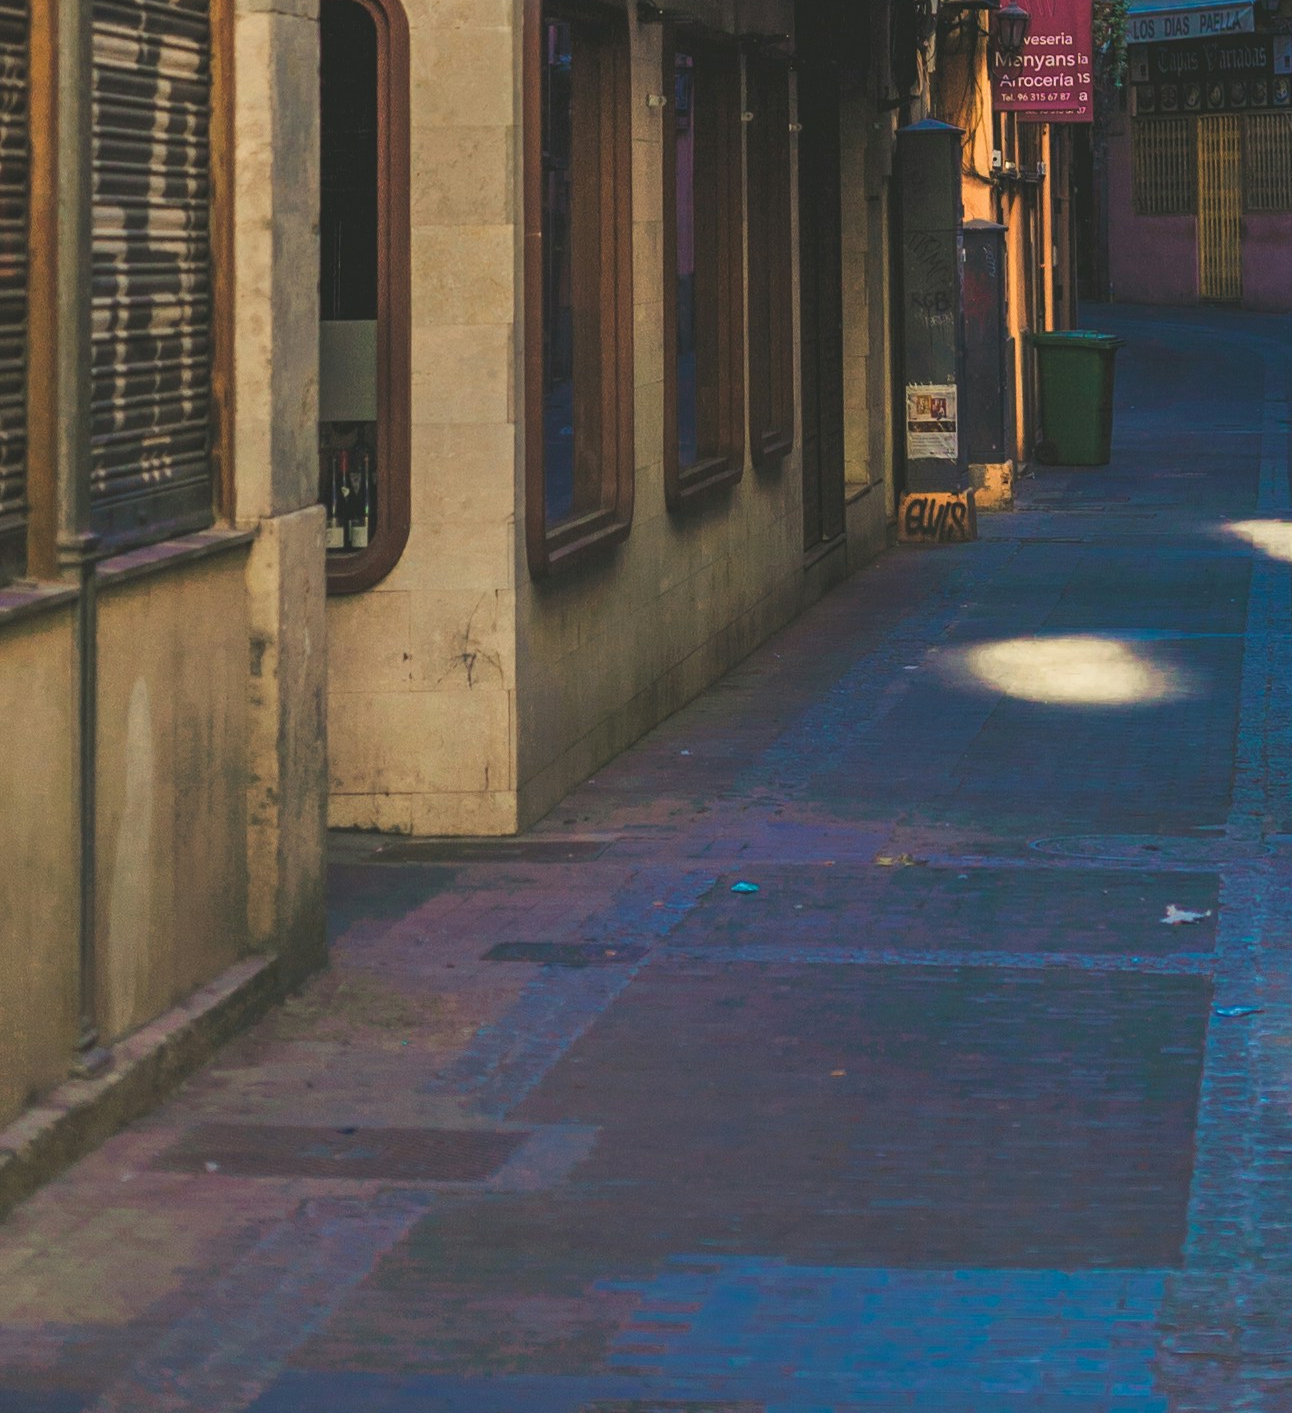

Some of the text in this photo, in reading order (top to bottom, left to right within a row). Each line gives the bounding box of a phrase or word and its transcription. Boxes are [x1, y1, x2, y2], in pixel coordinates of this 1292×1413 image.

[1133, 19, 1155, 40] LOS
[1200, 10, 1242, 35] PAELLA
[1157, 42, 1267, 77] Tapas Variadas
[1017, 93, 1028, 102] 96
[1030, 93, 1046, 102] 315
[1047, 93, 1058, 102] 67
[1060, 92, 1071, 101] 87
